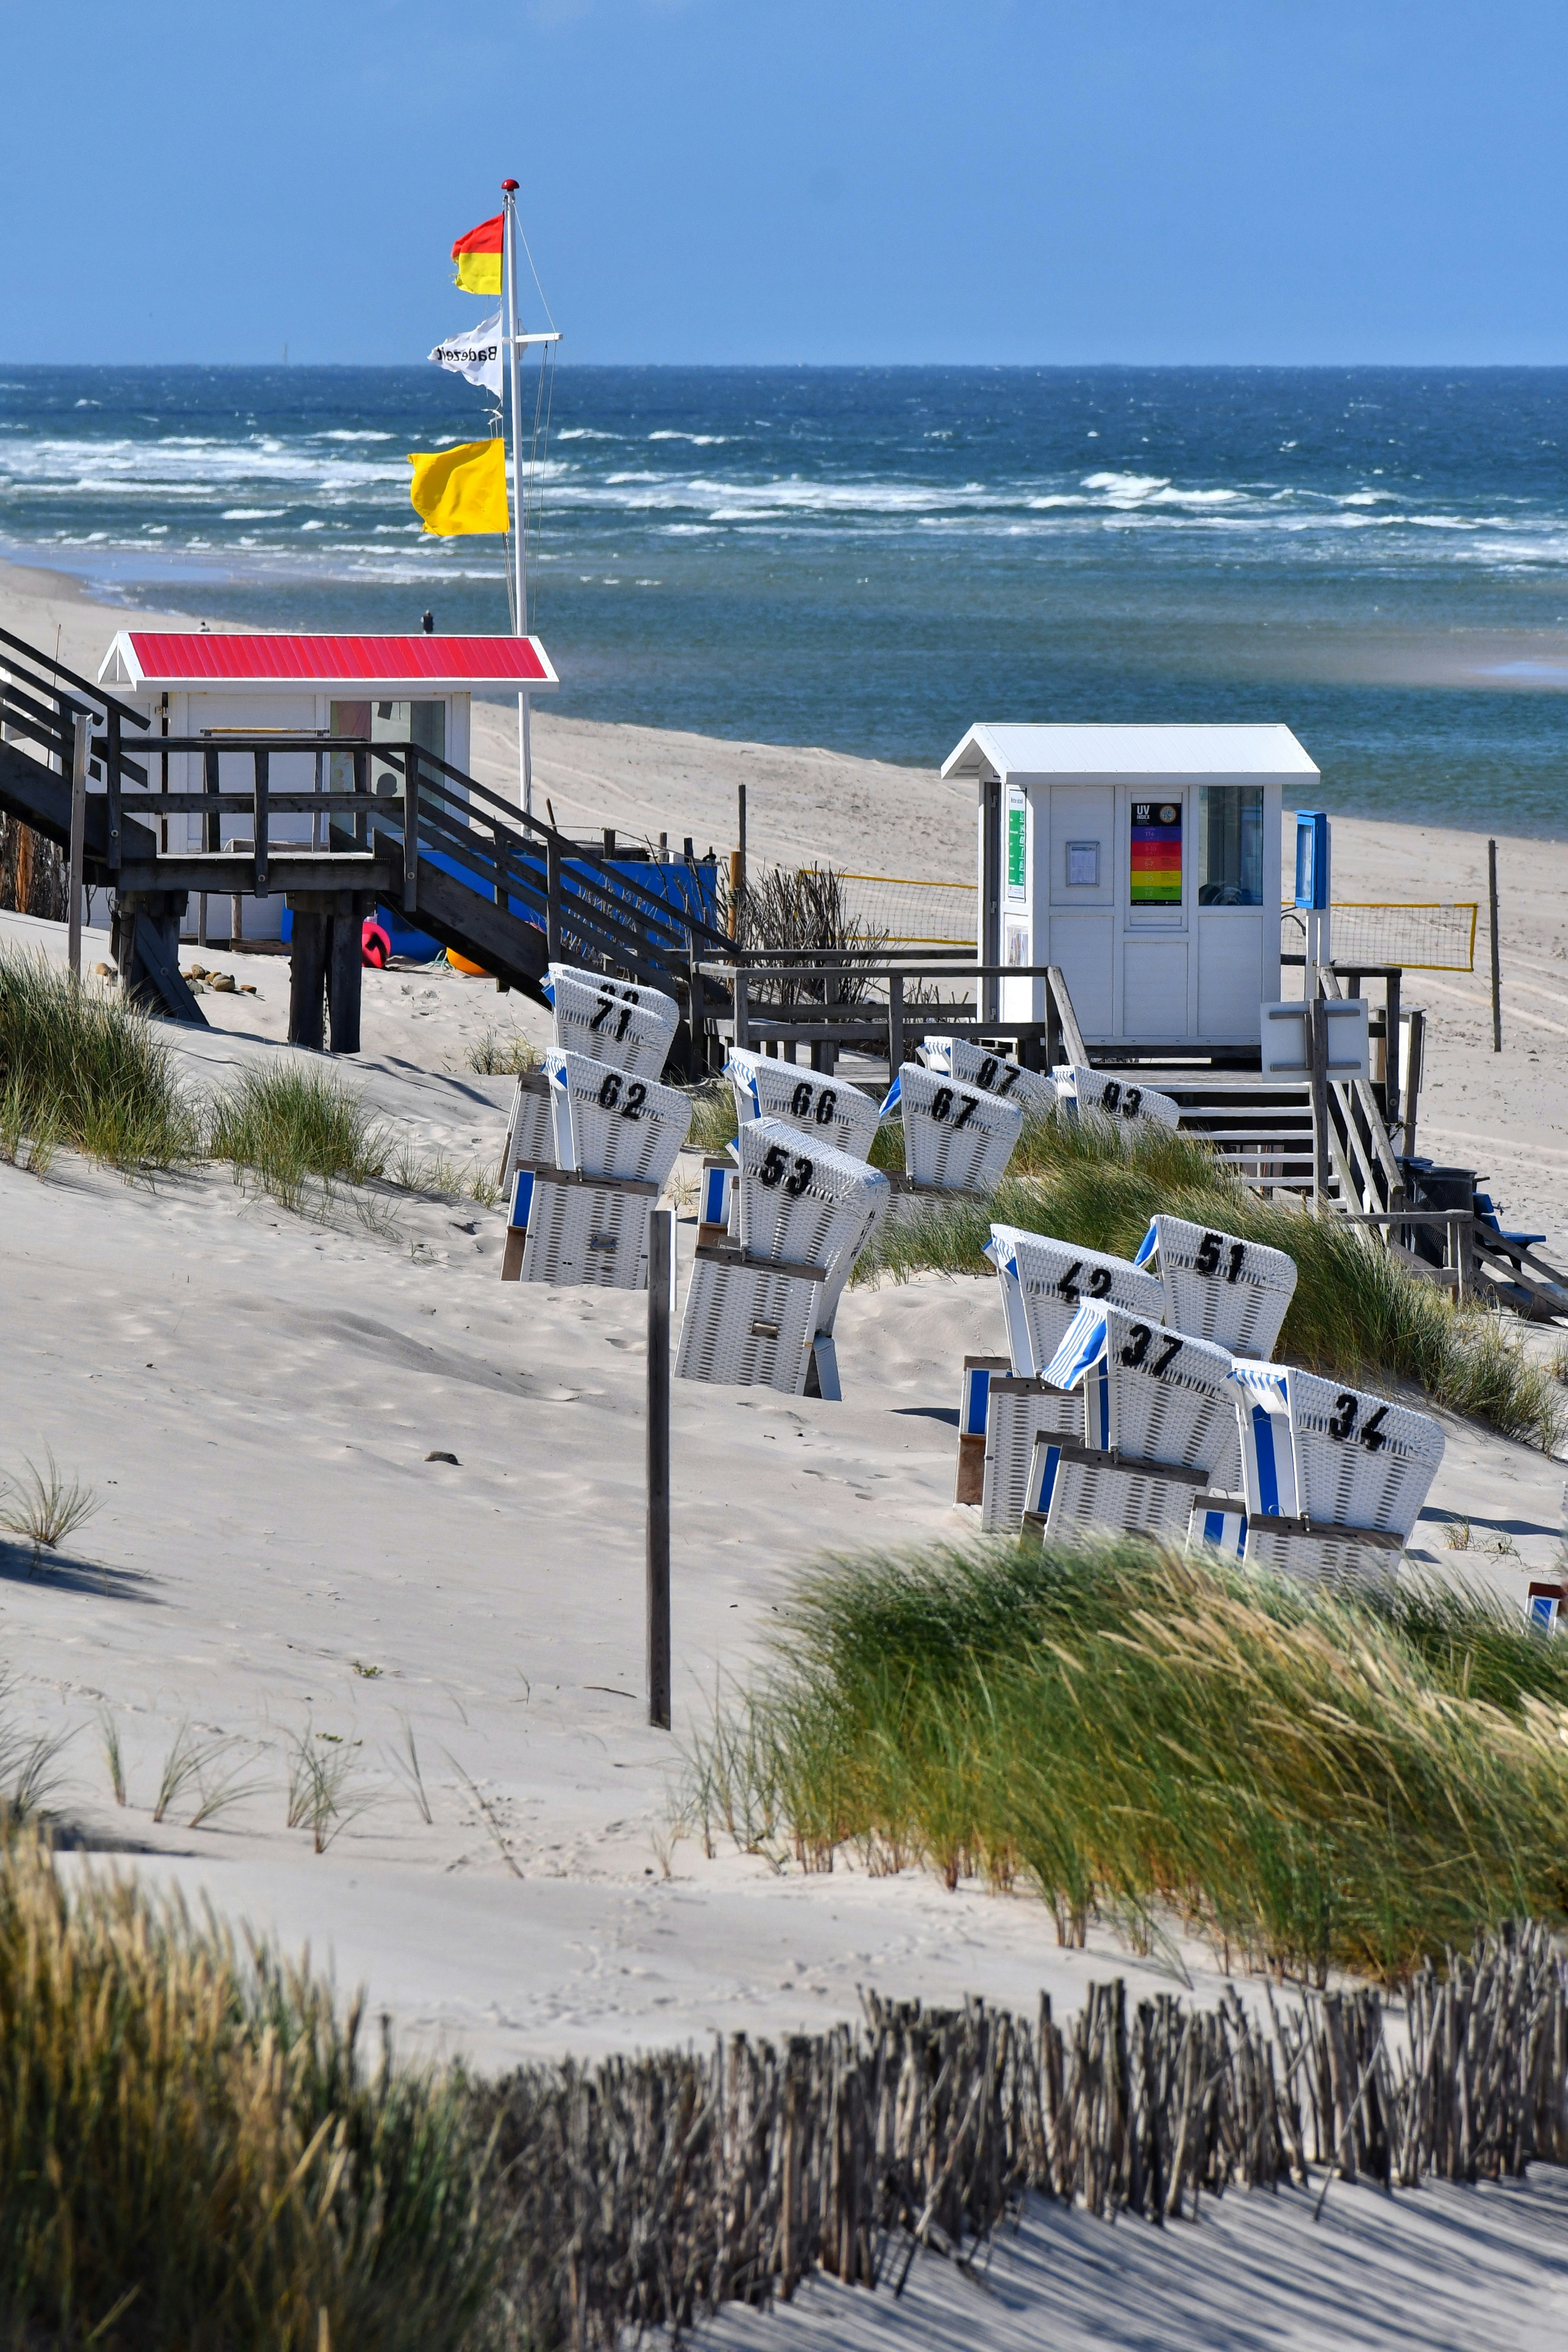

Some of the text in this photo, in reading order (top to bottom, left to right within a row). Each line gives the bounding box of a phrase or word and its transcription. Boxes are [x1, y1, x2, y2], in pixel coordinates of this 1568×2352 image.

[1137, 805, 1150, 815] UV
[591, 998, 632, 1041] 71
[599, 1073, 646, 1120] 62
[792, 1083, 836, 1124] 66
[931, 1088, 979, 1129] 67
[761, 1145, 813, 1196] 53
[1195, 1233, 1244, 1282] 51
[1057, 1262, 1112, 1302] 42
[1122, 1324, 1184, 1377] 37
[1329, 1394, 1389, 1451] 34
